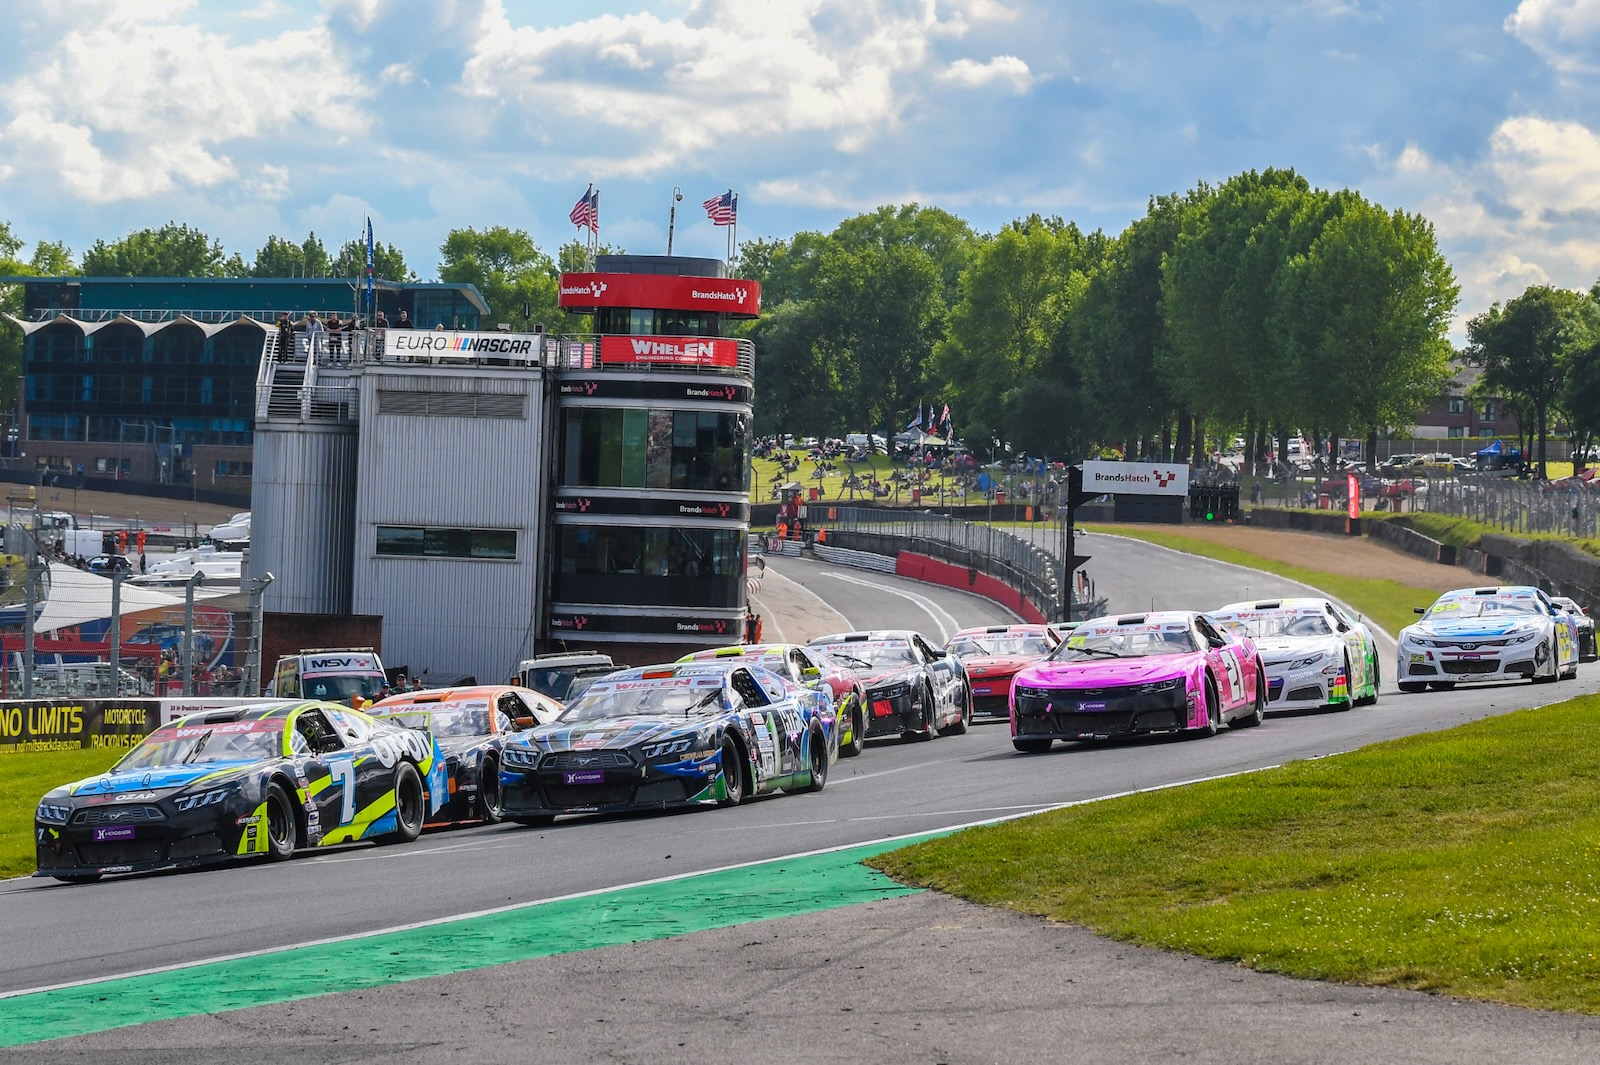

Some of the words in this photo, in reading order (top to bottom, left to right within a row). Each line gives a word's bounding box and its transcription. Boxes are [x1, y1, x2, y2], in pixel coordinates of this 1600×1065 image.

[692, 290, 736, 301] BrandsHatch
[396, 336, 447, 351] EURO
[467, 338, 532, 354] NASCAR
[631, 339, 714, 358] WHELEN
[687, 388, 724, 398] BrandsHatch
[1095, 472, 1150, 483] BrandsHatch
[1431, 602, 1459, 614] 69
[1095, 624, 1161, 635] WHELEN
[1067, 635, 1086, 648] 21
[312, 658, 352, 669] MSV
[615, 679, 691, 690] WHELEN
[388, 701, 461, 714] WHELEN
[0, 708, 22, 737] NO
[28, 706, 83, 735] LIMITS
[104, 708, 147, 724] MOTORCYCLE
[91, 734, 130, 749] TRACKDAYS
[329, 759, 356, 826] 7
[37, 828, 45, 840] 7
